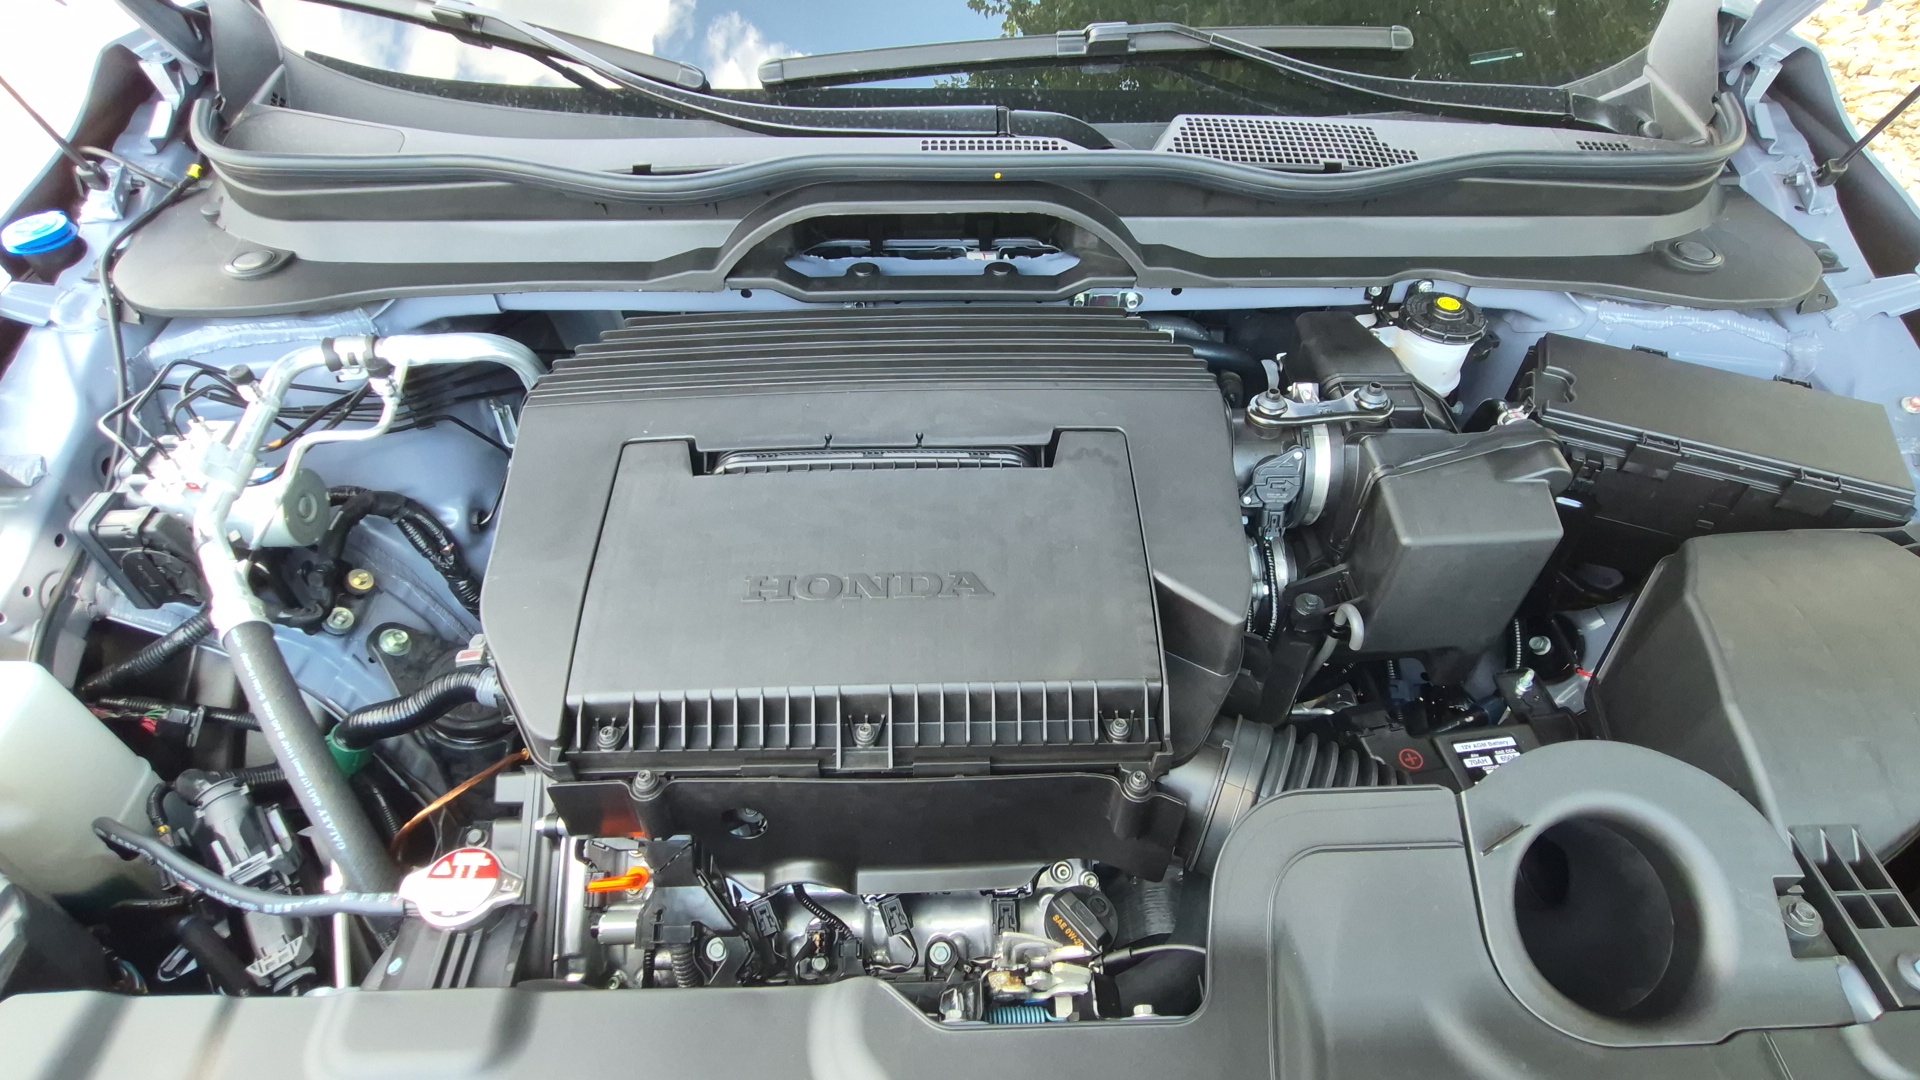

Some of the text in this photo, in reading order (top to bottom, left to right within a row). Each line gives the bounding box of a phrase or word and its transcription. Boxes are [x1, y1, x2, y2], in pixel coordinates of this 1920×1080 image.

[741, 572, 995, 602] HONDA
[1469, 758, 1488, 766] 70AH
[317, 809, 347, 851] GALAXY
[1052, 914, 1068, 930] SAE
